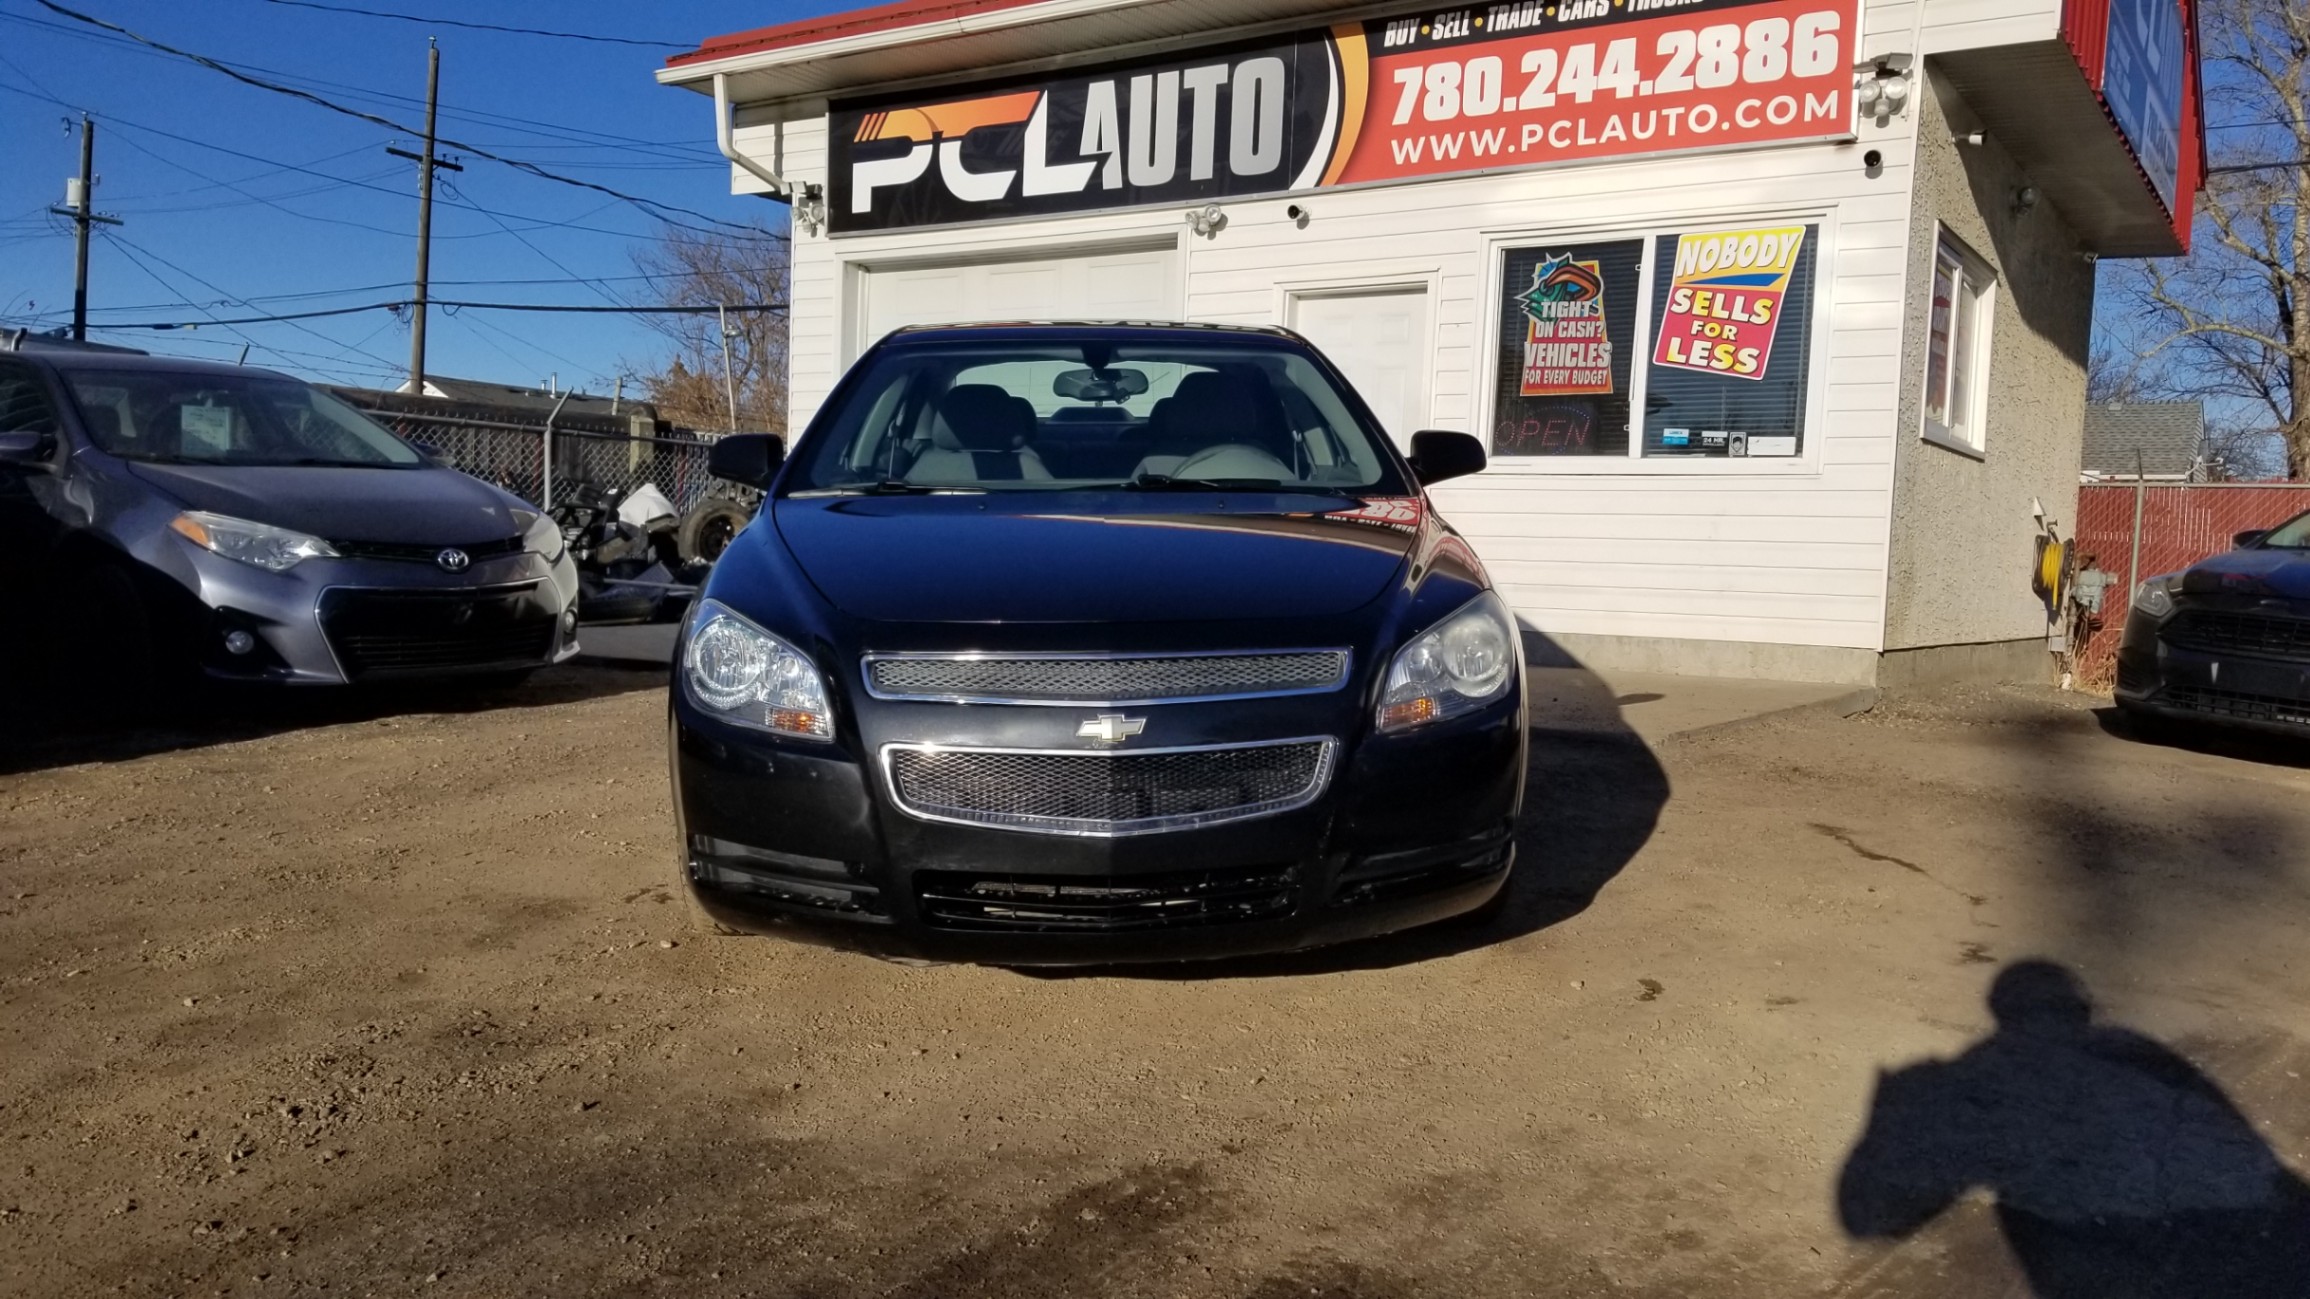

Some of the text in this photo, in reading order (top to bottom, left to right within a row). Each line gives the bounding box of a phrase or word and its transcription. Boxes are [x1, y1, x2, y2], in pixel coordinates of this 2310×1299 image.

[1384, 18, 1420, 47] BUY
[1432, 10, 1470, 40] SELL
[1487, 0, 1544, 32] TRADE
[1391, 10, 1840, 126] 780.244.2886
[1390, 90, 1839, 165] WWW.PCLAUTO.COM
[1676, 233, 1800, 278] NOBODY
[1541, 300, 1594, 318] TIGHT
[1670, 288, 1774, 325] SELLS
[1535, 320, 1606, 338] ON CASH?
[1690, 320, 1738, 341] FOR
[1524, 342, 1612, 368] VEHICLES
[1666, 336, 1760, 374] LESS
[1525, 368, 1608, 385] FOR EVERY BUDGET
[1494, 417, 1590, 447] OPEN
